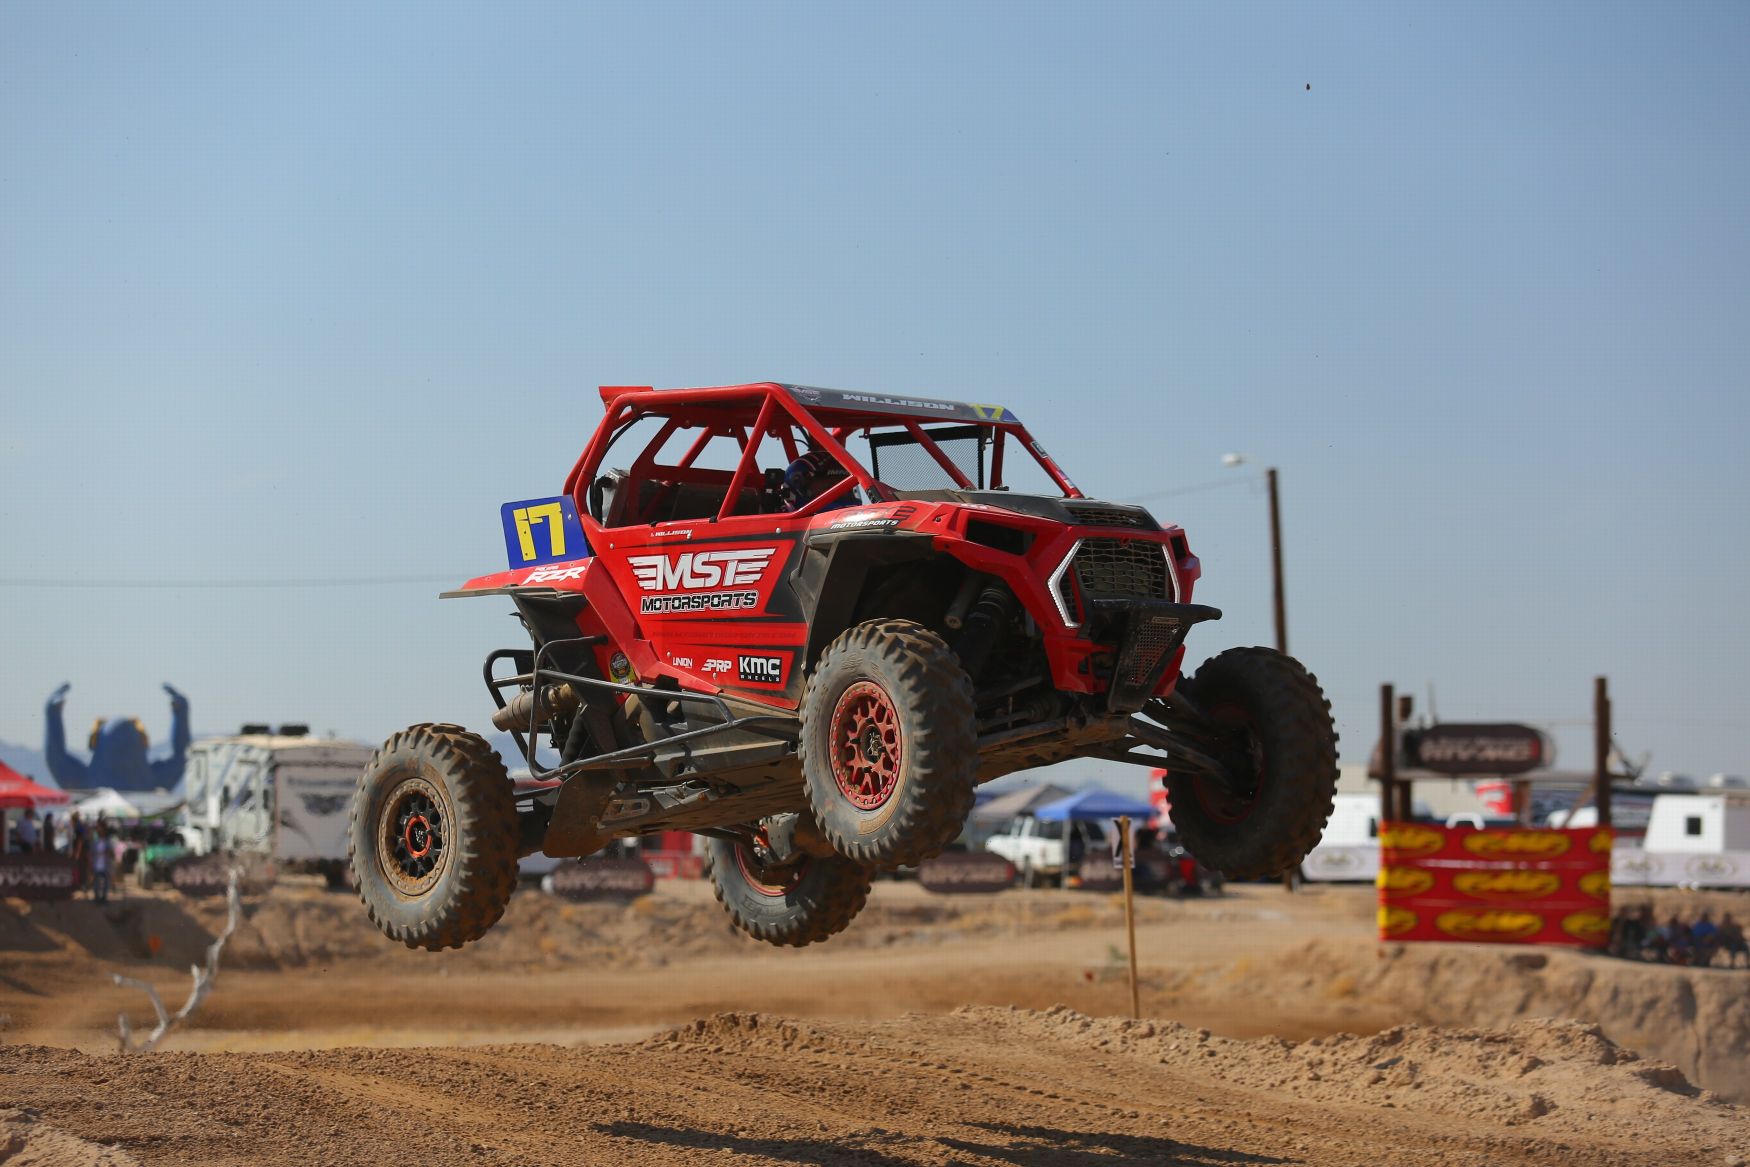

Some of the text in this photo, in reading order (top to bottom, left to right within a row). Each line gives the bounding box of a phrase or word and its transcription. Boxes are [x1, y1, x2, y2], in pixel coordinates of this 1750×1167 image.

[842, 394, 955, 410] WILLISON
[512, 501, 566, 561] 17
[830, 519, 899, 530] MOTORSPORTS
[521, 566, 586, 585] RZR
[627, 548, 776, 591] MST
[640, 591, 759, 614] MOTORSPORTS
[739, 656, 781, 675] KMC
